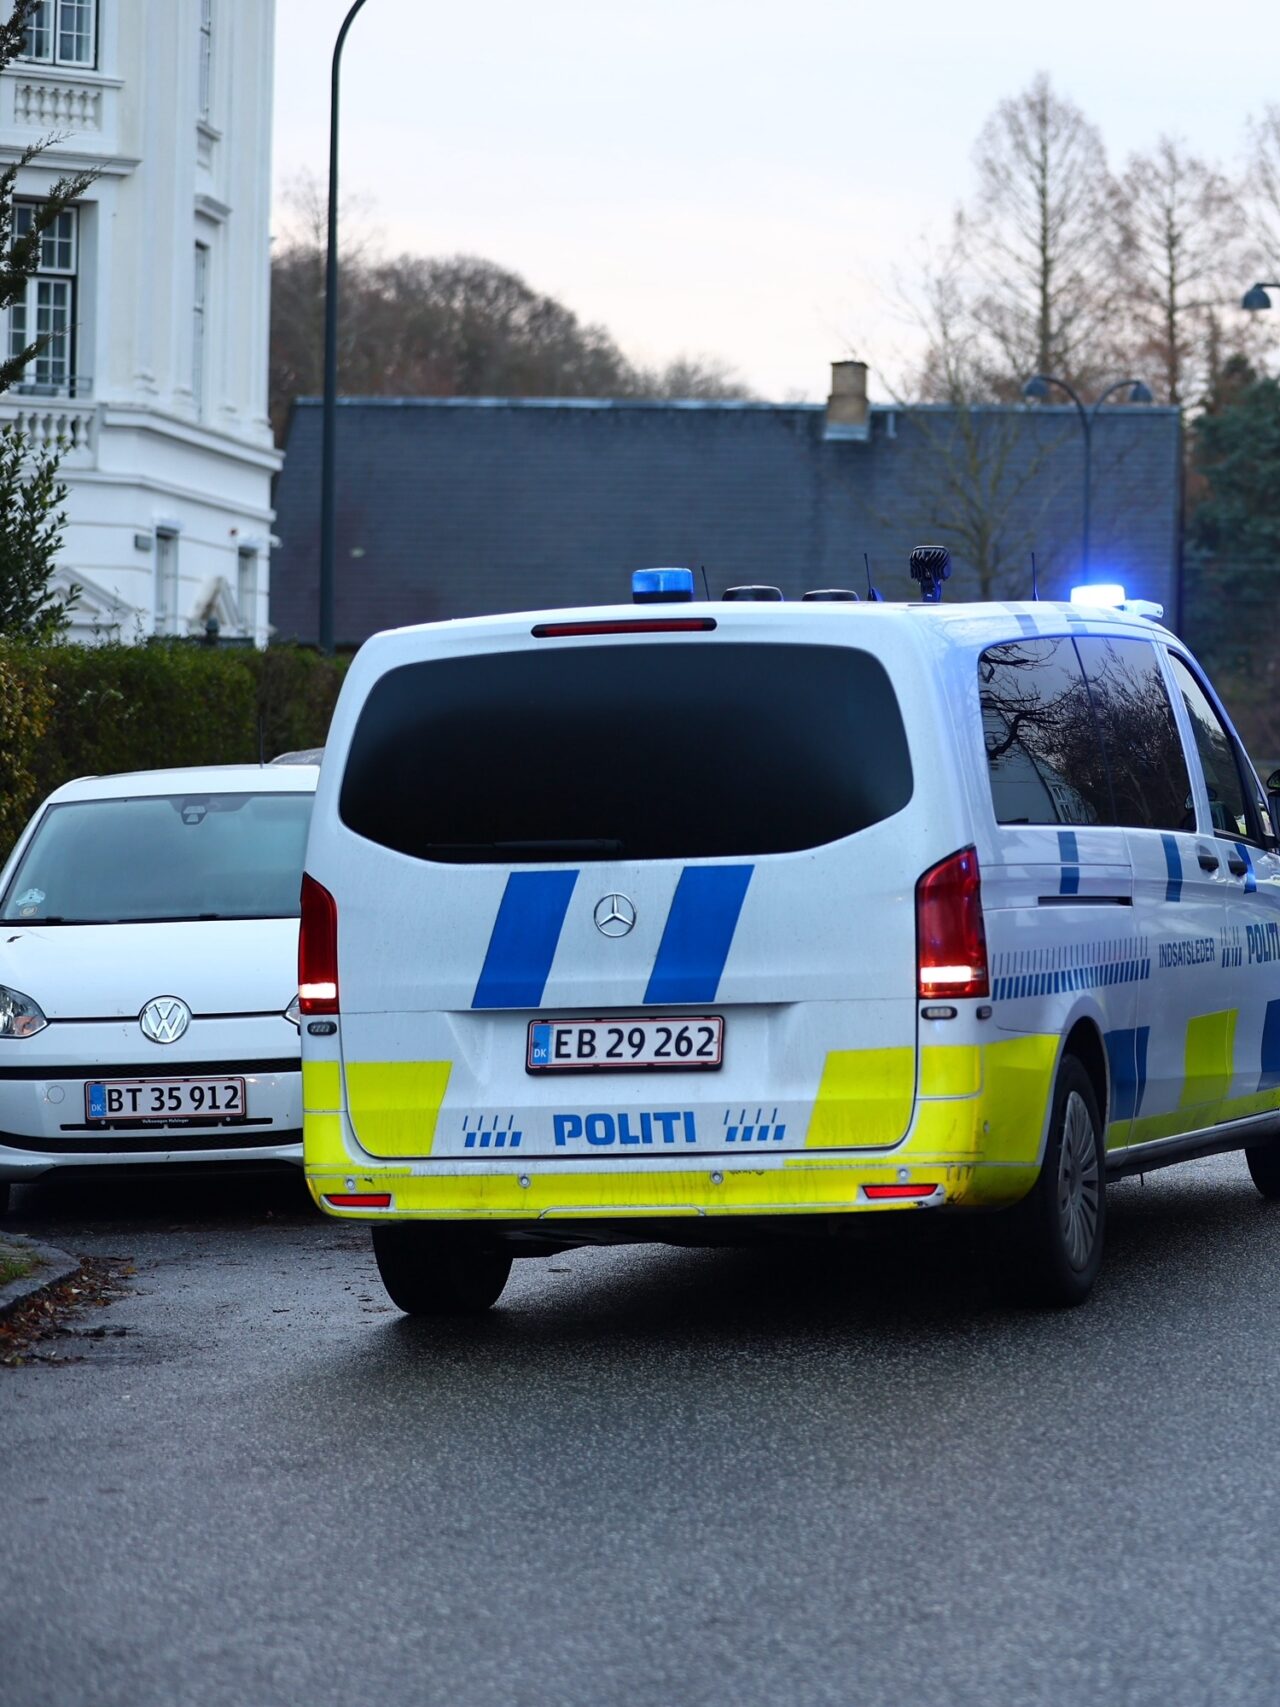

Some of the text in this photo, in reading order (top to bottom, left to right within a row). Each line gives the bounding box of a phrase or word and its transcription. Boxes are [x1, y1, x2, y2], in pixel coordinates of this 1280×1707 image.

[1159, 938, 1215, 968] INDSATSLEDER
[1246, 922, 1280, 964] POLITI
[534, 1048, 547, 1058] DK
[554, 1025, 715, 1059] EB 29 262
[91, 1104, 102, 1112] DK
[107, 1085, 239, 1112] BT 35 912
[553, 1111, 696, 1146] POLITI
